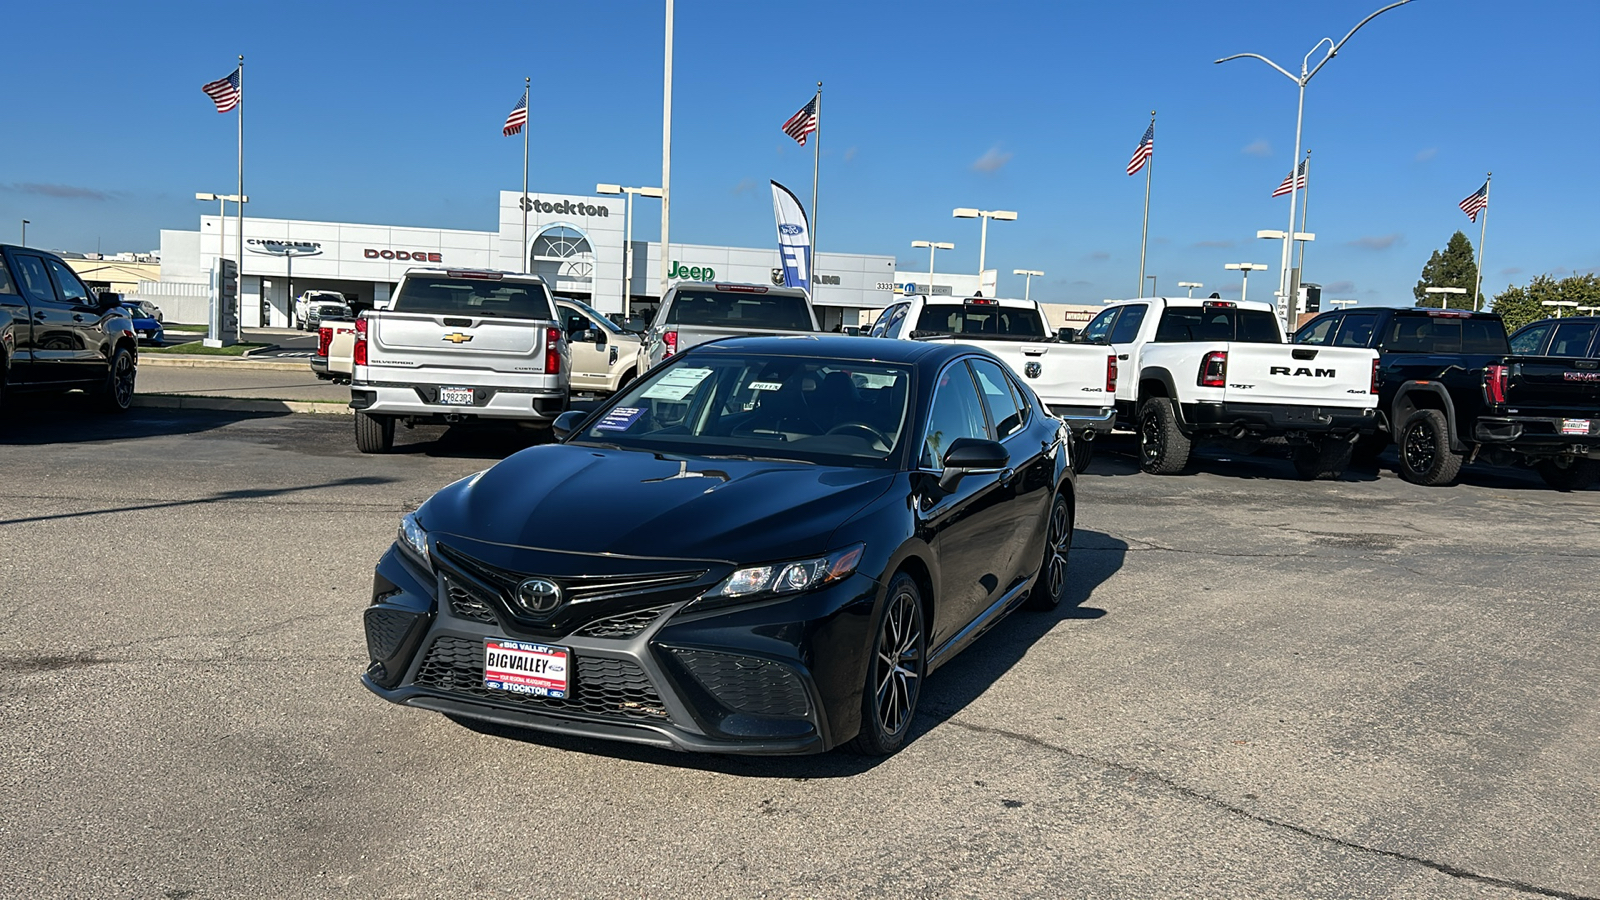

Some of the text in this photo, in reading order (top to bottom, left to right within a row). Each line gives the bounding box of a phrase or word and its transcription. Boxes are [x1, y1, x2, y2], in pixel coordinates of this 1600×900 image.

[519, 196, 609, 217] Stockton
[246, 239, 321, 248] CHRYSLER
[364, 248, 443, 263] DODGE
[667, 260, 715, 282] Jeep
[876, 282, 893, 290] 3333
[1269, 366, 1336, 378] RAM
[519, 643, 549, 653] VALLEY
[488, 652, 549, 674] BIGVALLEY
[502, 682, 548, 696] STOCKTON
